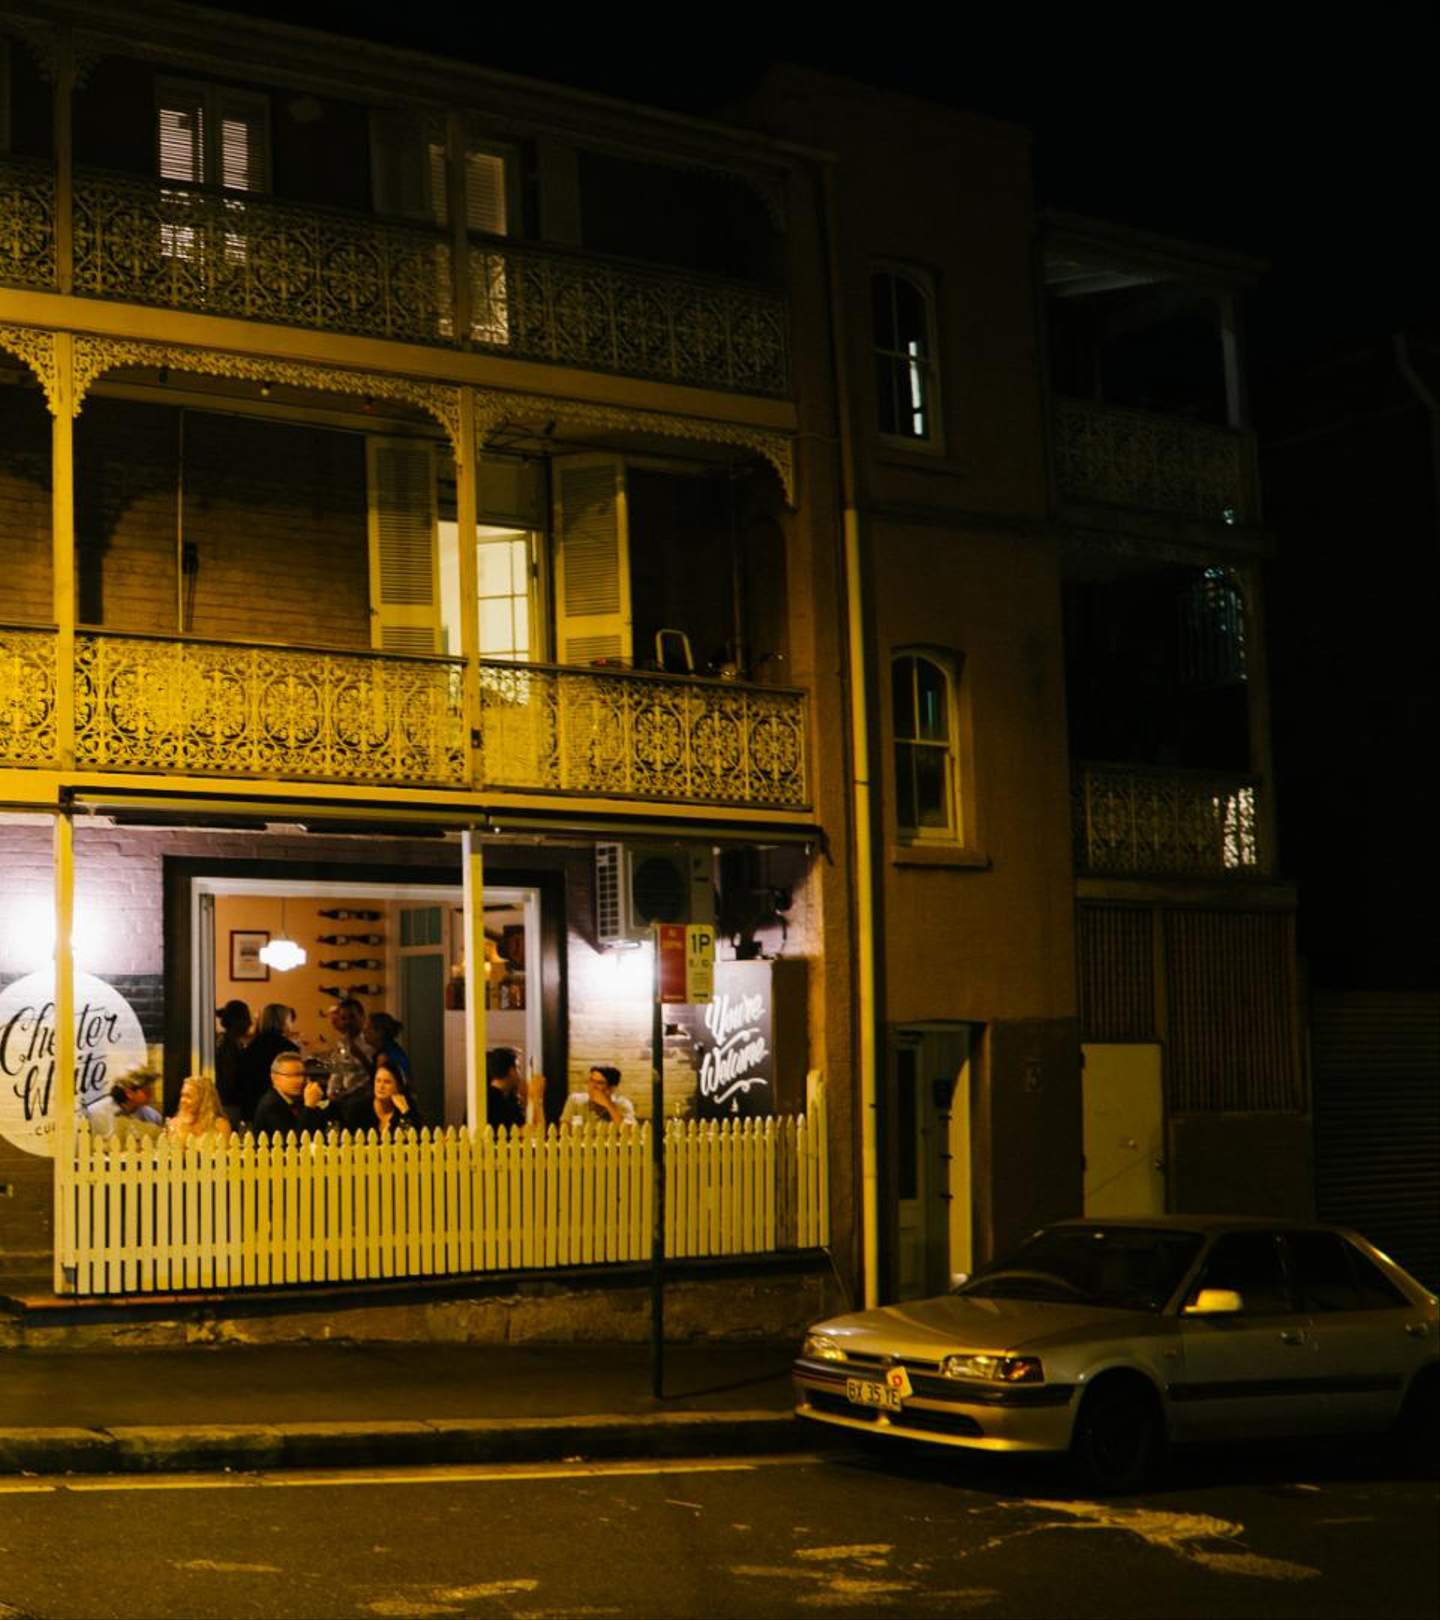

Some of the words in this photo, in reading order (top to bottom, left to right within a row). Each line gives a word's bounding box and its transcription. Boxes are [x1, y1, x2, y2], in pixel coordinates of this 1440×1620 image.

[692, 934, 711, 954] 1P
[13, 1053, 109, 1121] Wite
[700, 1037, 769, 1096] Welcome
